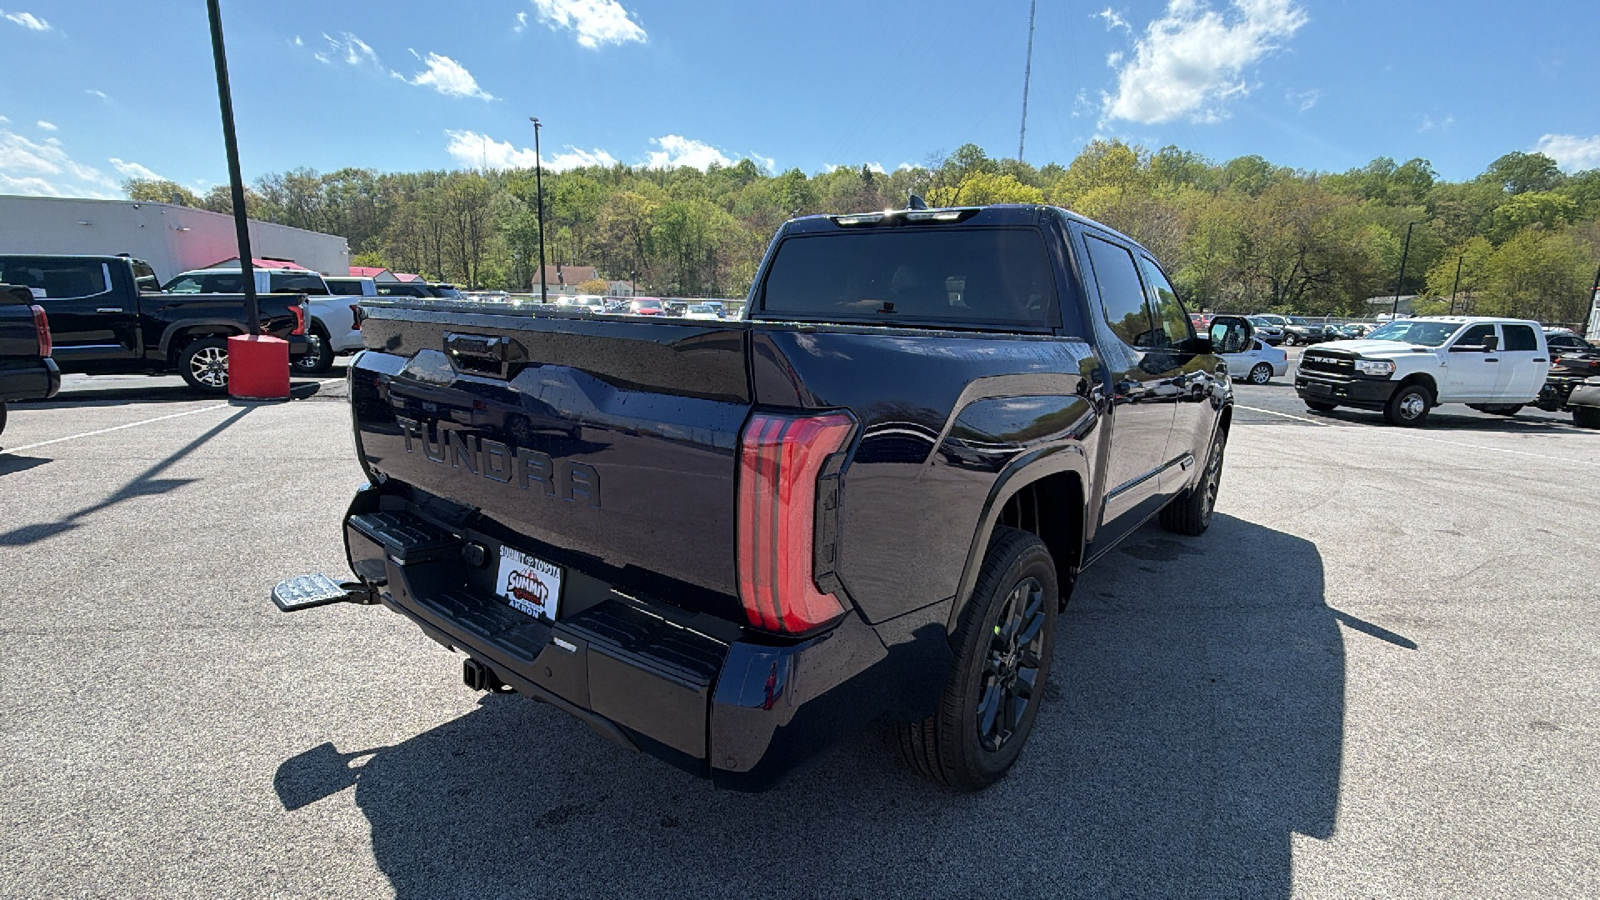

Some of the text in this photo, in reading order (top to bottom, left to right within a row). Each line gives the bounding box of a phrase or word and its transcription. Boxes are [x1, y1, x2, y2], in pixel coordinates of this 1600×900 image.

[1314, 356, 1338, 364] RAM
[396, 415, 601, 509] TUNDRA
[500, 545, 561, 579] SUMMIT TOYOTA
[508, 572, 547, 605] SUMMIT
[509, 601, 538, 618] AKRON
